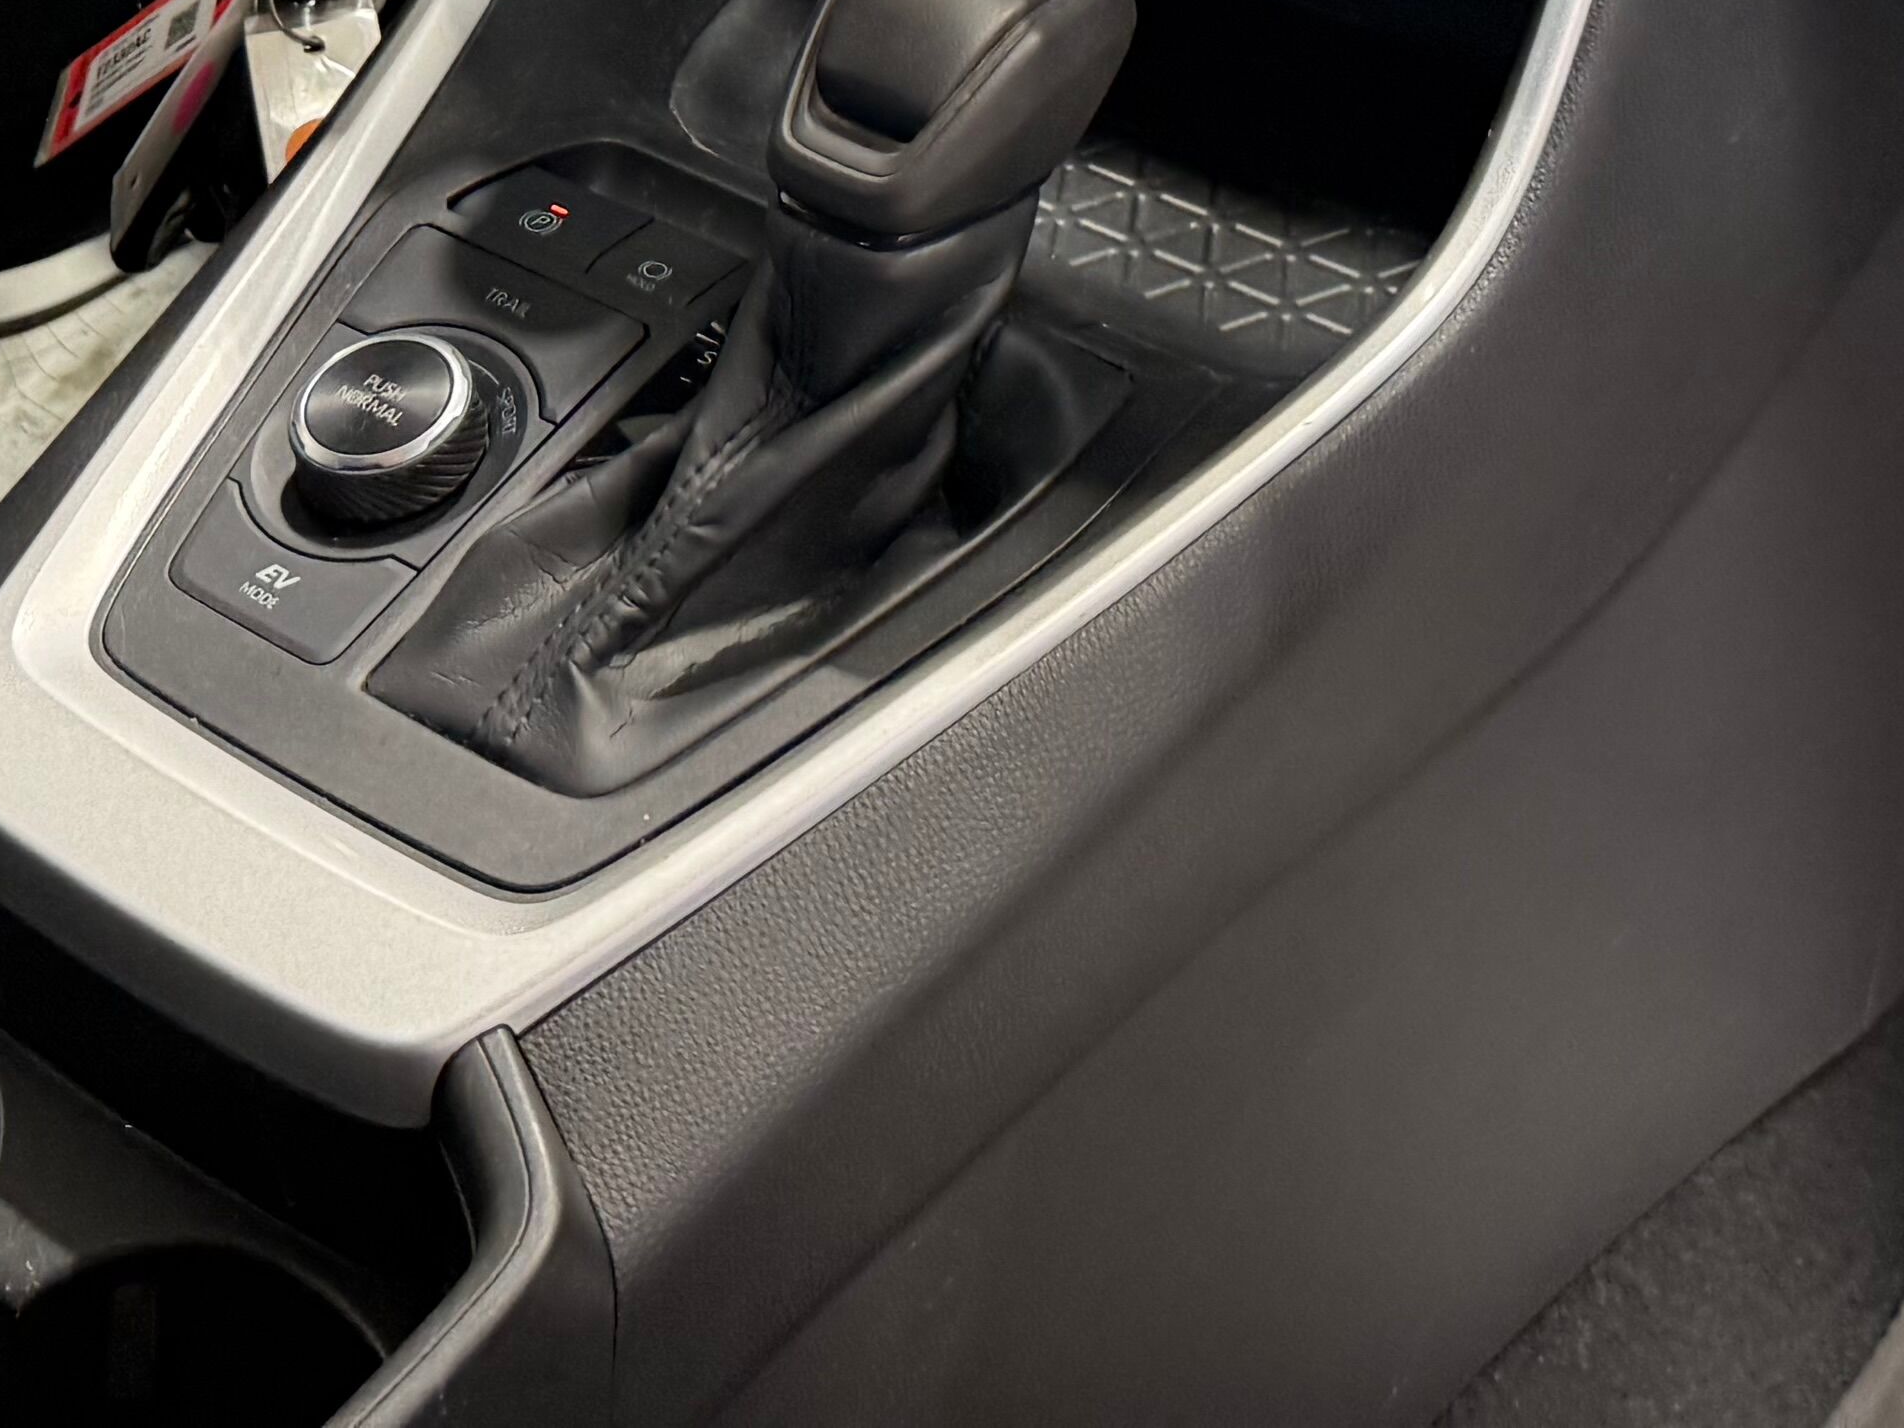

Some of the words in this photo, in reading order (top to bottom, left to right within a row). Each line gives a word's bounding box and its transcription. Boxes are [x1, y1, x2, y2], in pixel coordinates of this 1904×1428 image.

[362, 373, 407, 402] PUSH
[335, 384, 404, 427] NORMAL
[255, 563, 301, 590] EV
[238, 580, 280, 610] MODE
